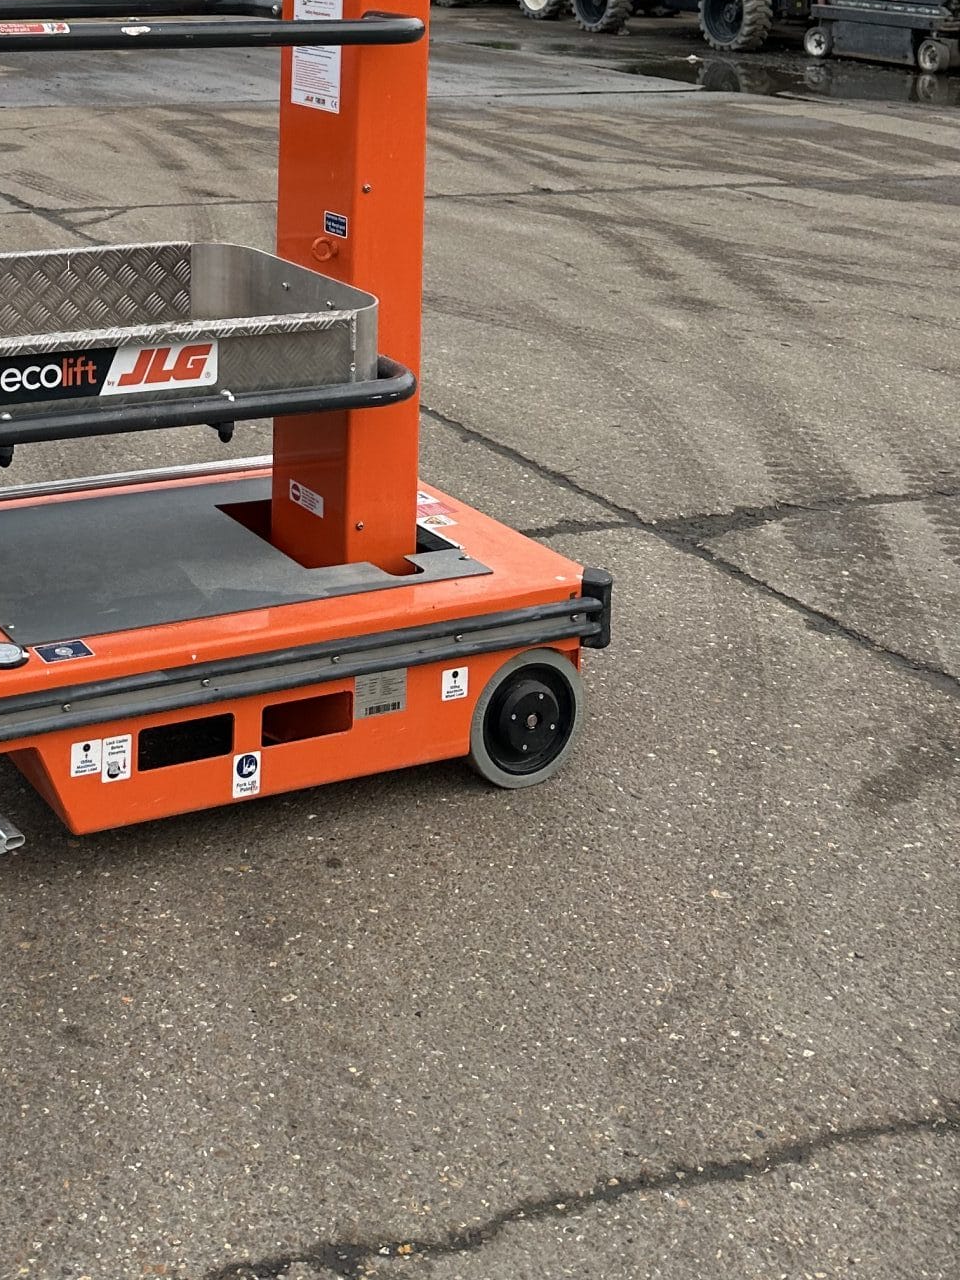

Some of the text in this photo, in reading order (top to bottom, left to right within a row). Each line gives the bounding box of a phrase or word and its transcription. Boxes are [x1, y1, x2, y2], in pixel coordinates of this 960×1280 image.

[0, 343, 213, 393] ecolift by JLG
